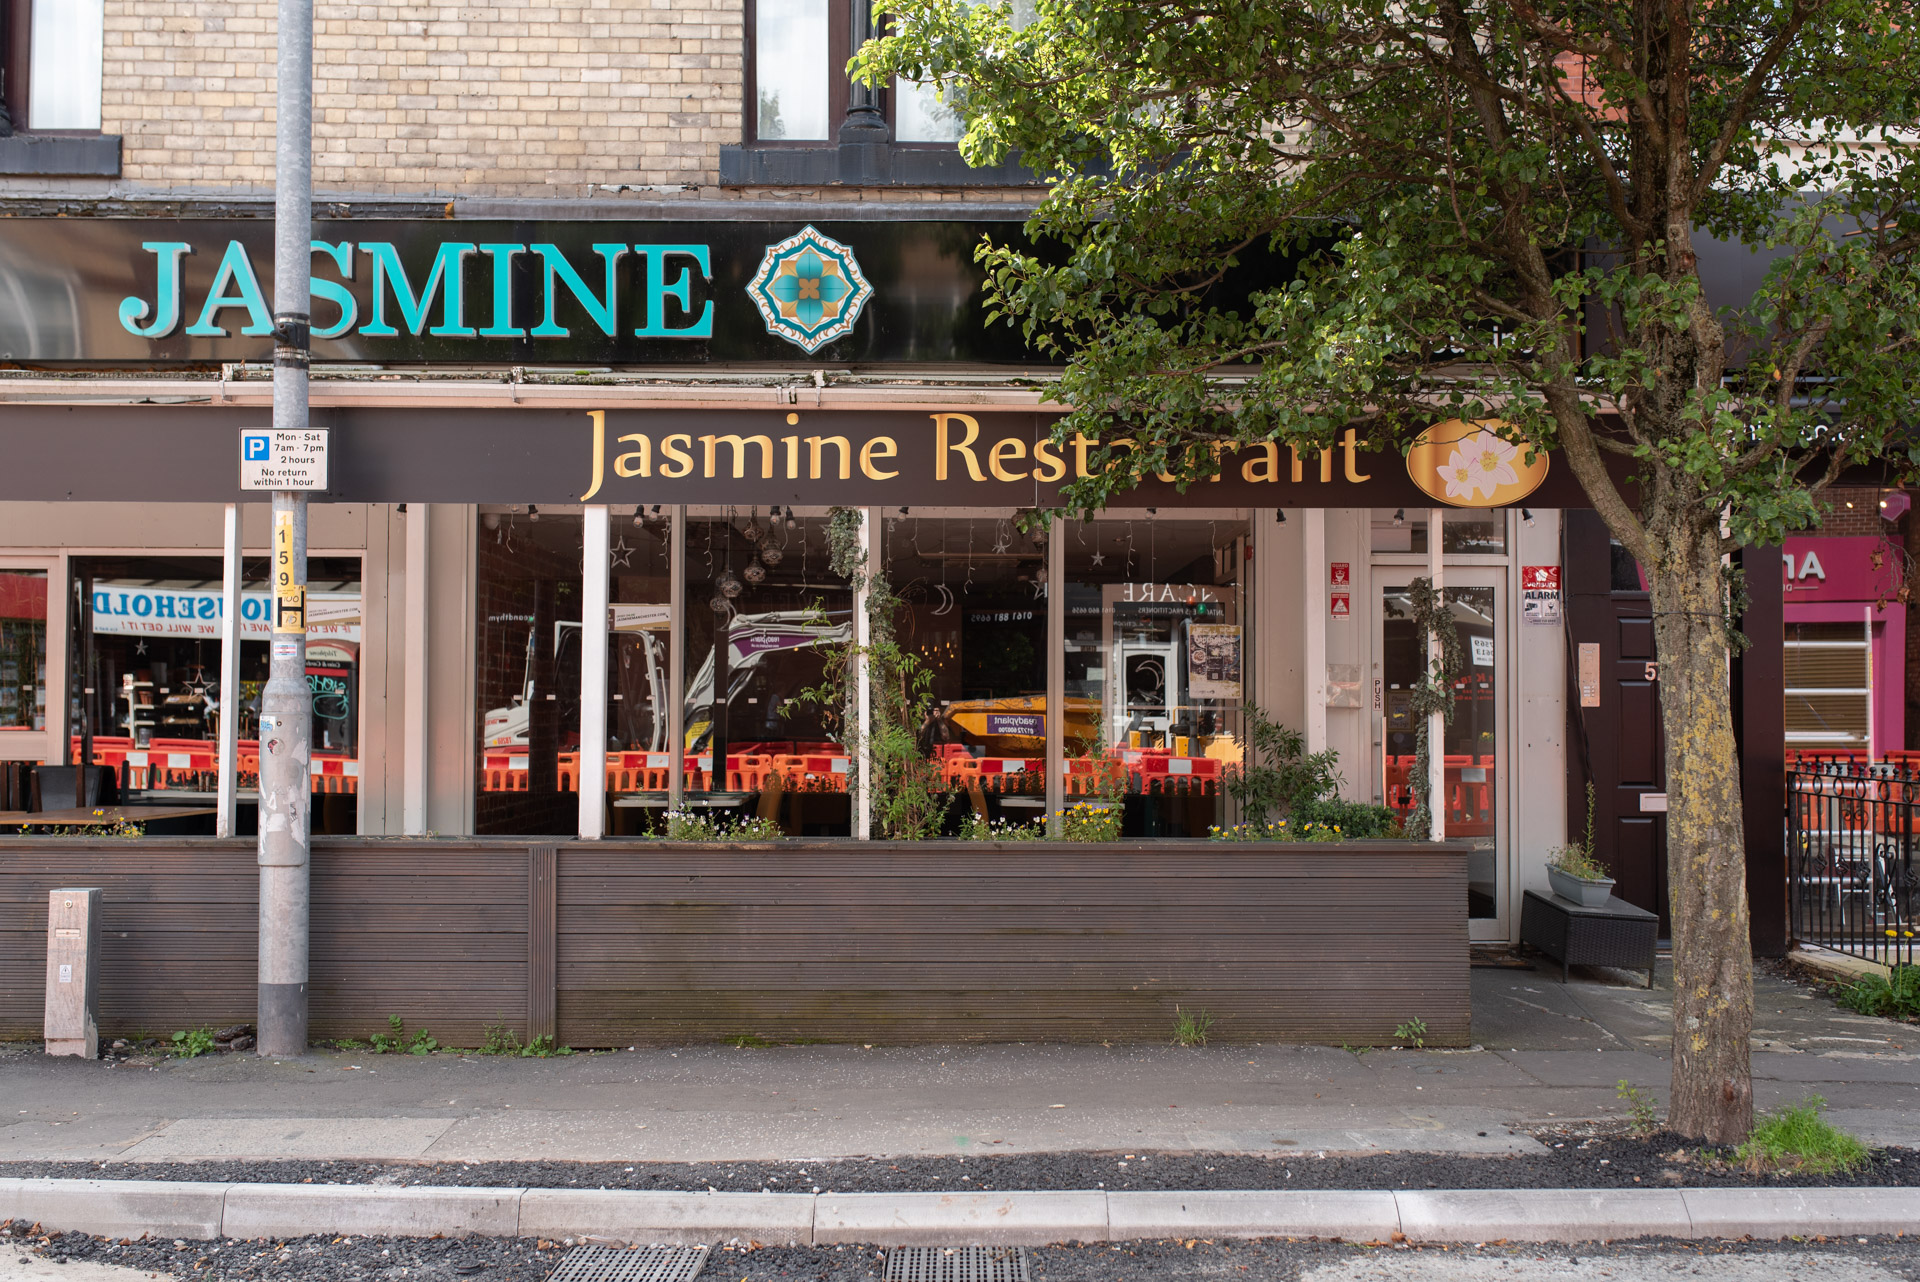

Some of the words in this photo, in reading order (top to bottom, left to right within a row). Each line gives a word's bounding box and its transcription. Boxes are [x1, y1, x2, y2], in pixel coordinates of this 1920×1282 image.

[119, 240, 714, 339] JASMINE
[276, 433, 297, 441] Mon
[304, 433, 320, 441] Sat
[274, 444, 295, 452] 7am
[303, 444, 324, 453] 7pm
[580, 409, 900, 502] Jasmine
[280, 456, 287, 464] 2
[288, 456, 316, 464] hours
[261, 468, 275, 476] No
[253, 478, 283, 486] within
[286, 478, 290, 486] 1
[292, 478, 314, 486] hour
[1524, 591, 1560, 600] ALARM
